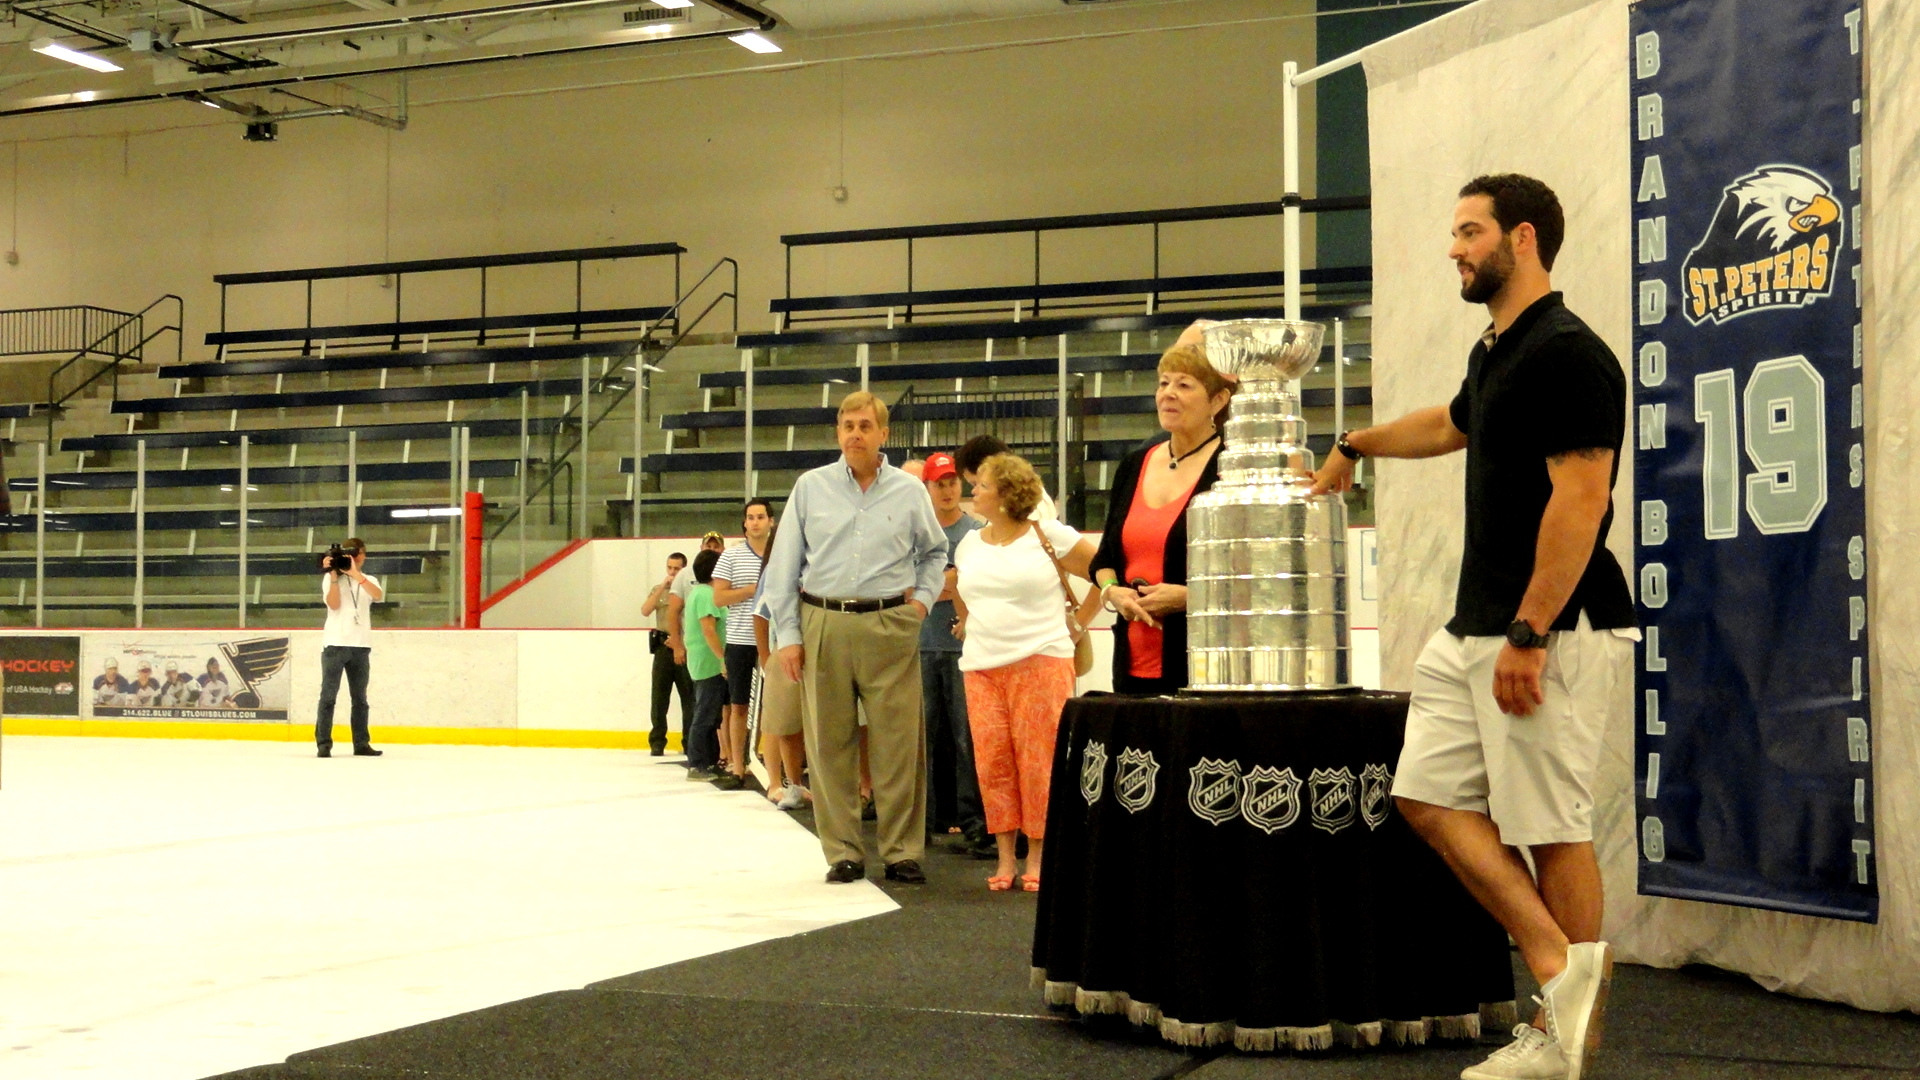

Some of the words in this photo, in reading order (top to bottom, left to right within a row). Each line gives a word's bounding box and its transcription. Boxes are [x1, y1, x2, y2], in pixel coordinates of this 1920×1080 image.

[1635, 30, 1667, 450] BRANDON
[1718, 290, 1800, 318] SPIRIT
[1694, 354, 1828, 540] 19
[13, 684, 28, 693] USA
[29, 685, 53, 695] Hockey
[1640, 499, 1669, 862] BOLLIG
[180, 710, 257, 719] STLOUISBLUES.COM
[1847, 535, 1871, 885] SPIRIT
[1204, 778, 1234, 805] NHL
[1256, 787, 1287, 813] NHL
[1320, 786, 1346, 816] NHL
